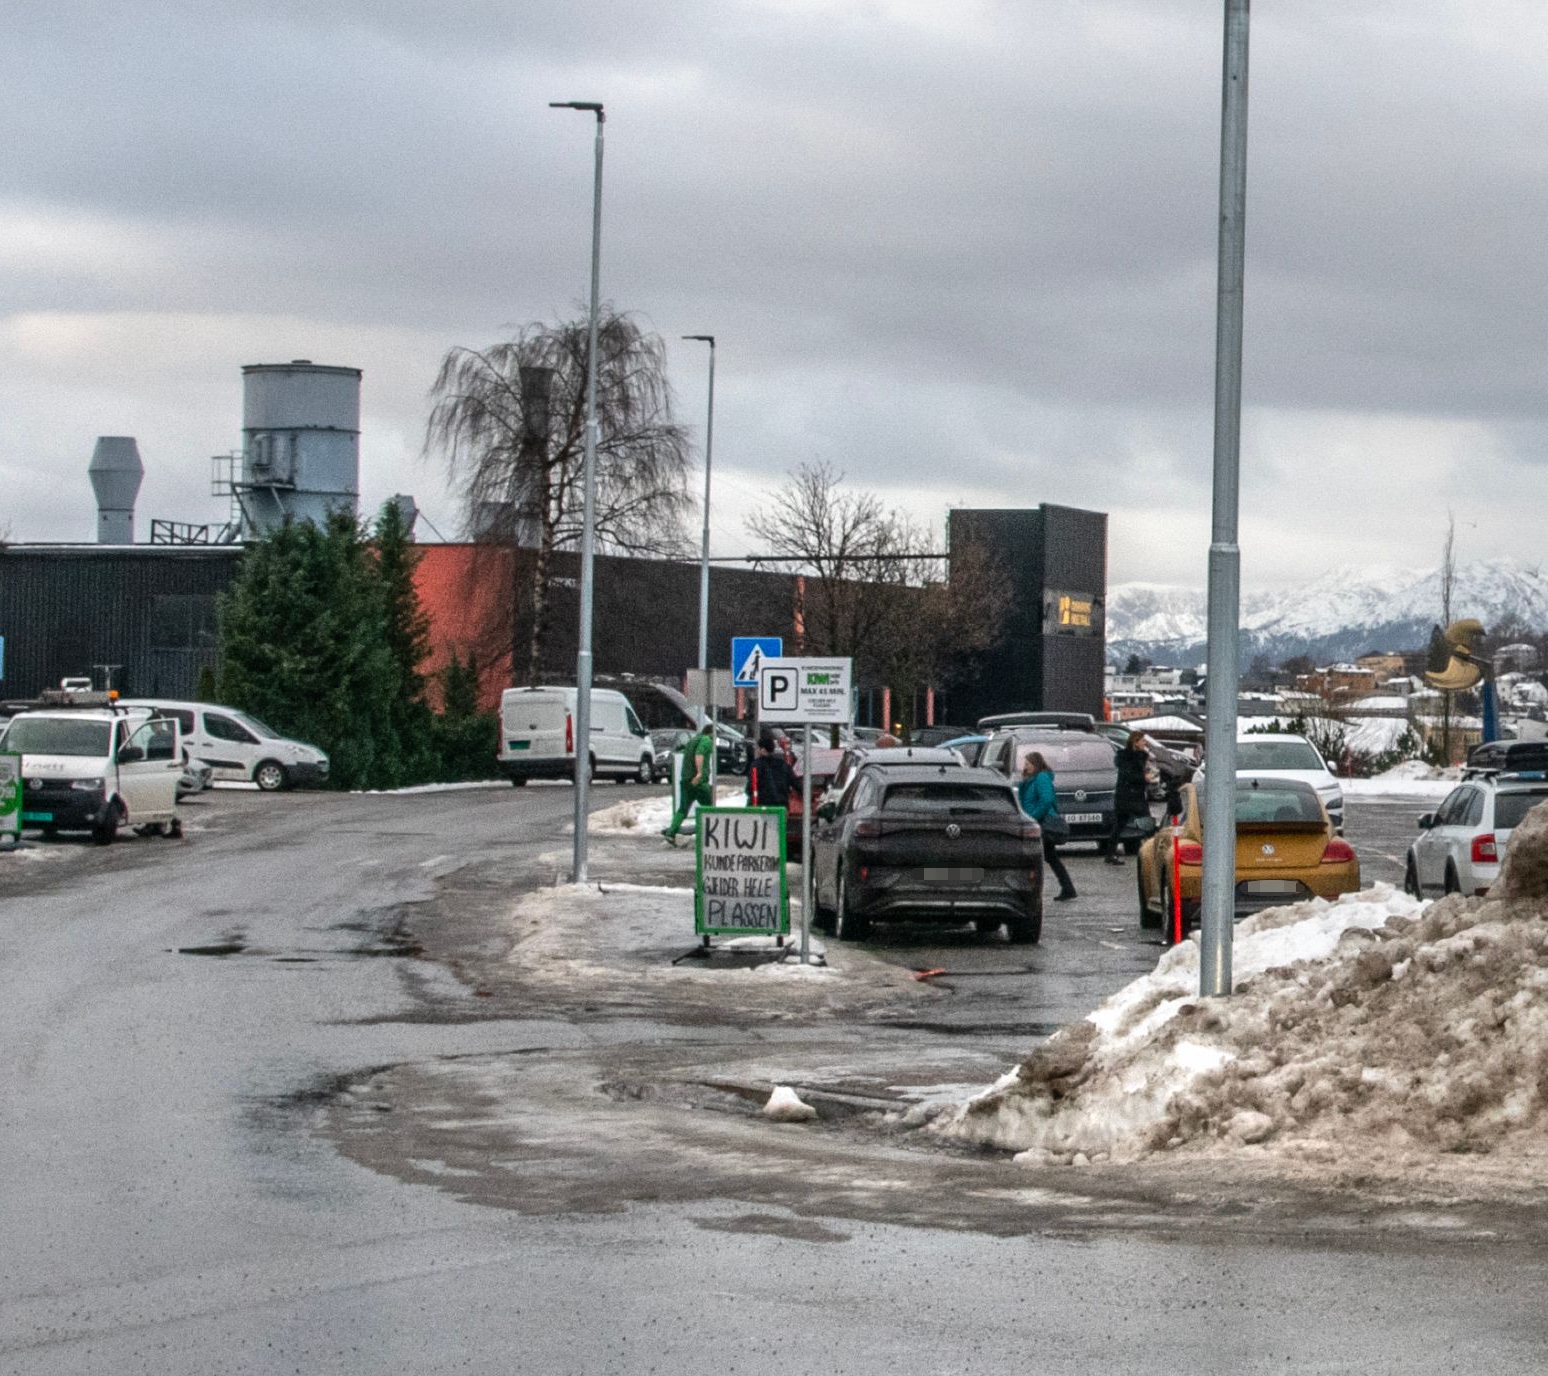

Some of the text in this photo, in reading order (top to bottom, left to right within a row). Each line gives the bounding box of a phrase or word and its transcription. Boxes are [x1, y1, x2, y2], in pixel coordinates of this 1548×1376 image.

[770, 675, 789, 703] P
[705, 817, 768, 850] KIWI
[744, 877, 773, 897] HELE
[708, 899, 778, 928] PLASSEN
